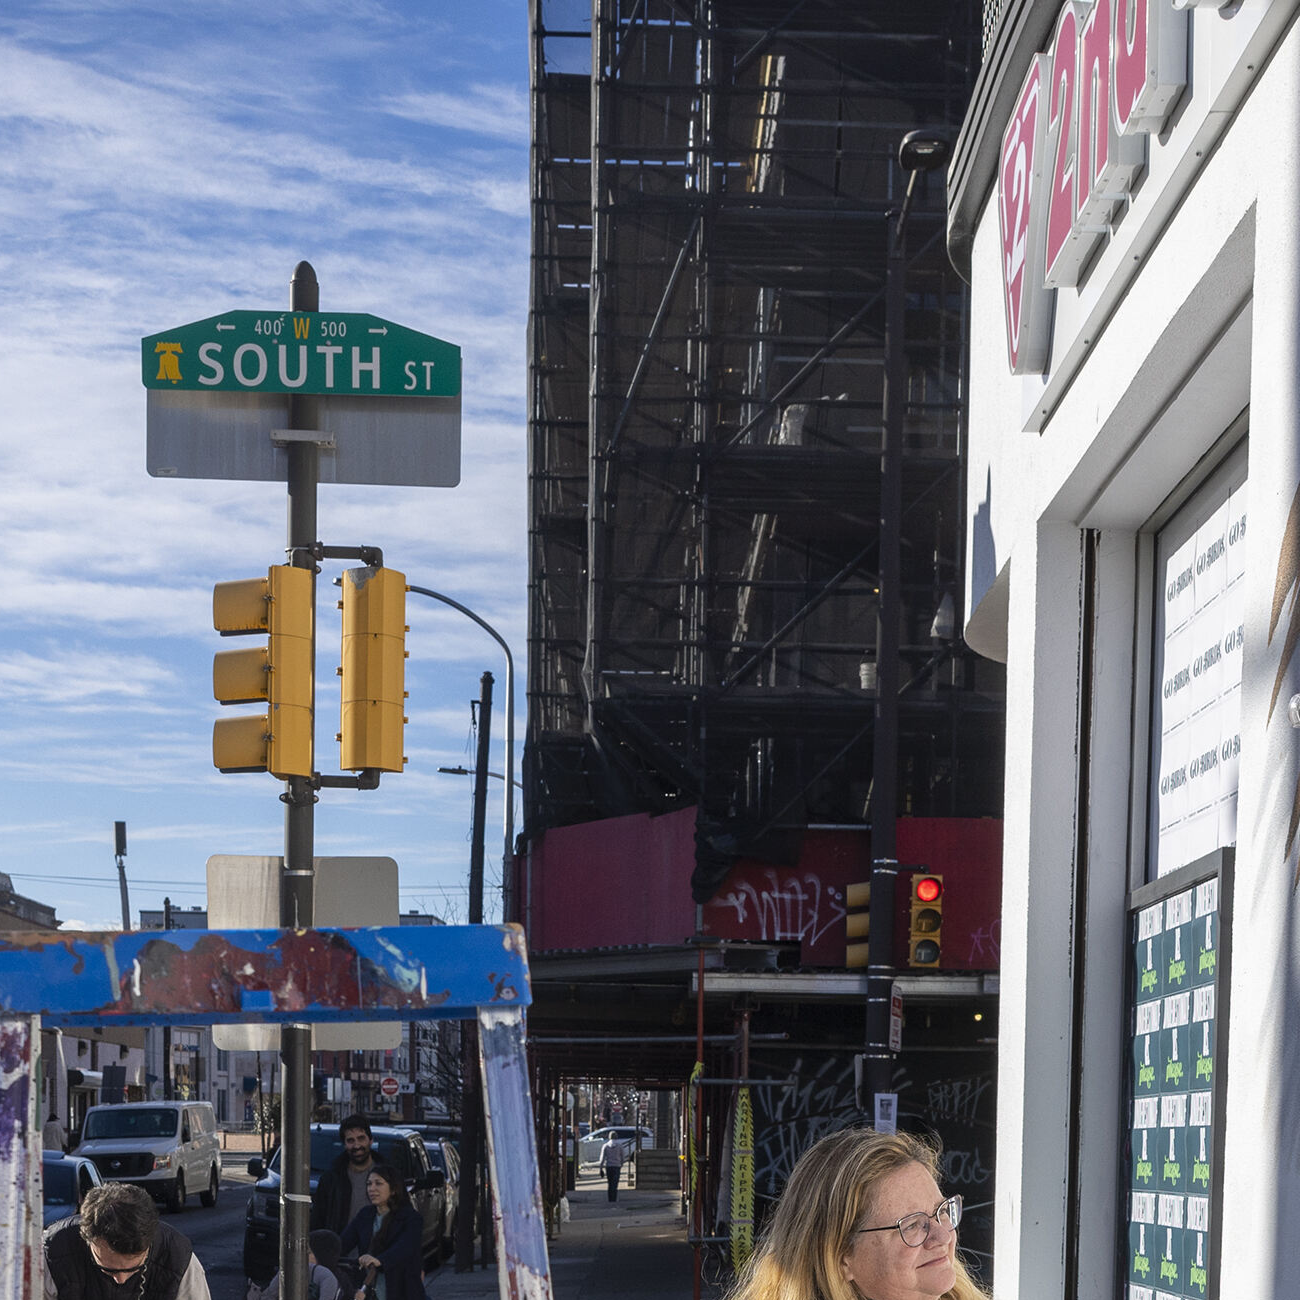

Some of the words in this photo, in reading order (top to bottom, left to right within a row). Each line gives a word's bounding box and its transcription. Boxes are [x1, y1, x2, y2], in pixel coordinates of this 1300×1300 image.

[254, 319, 282, 337] 400
[293, 317, 310, 340] W
[320, 321, 348, 338] 500
[197, 342, 381, 390] SOUTH
[404, 361, 435, 391] ST
[738, 1093, 749, 1147] WARNING
[738, 1155, 748, 1218] TRIPPING
